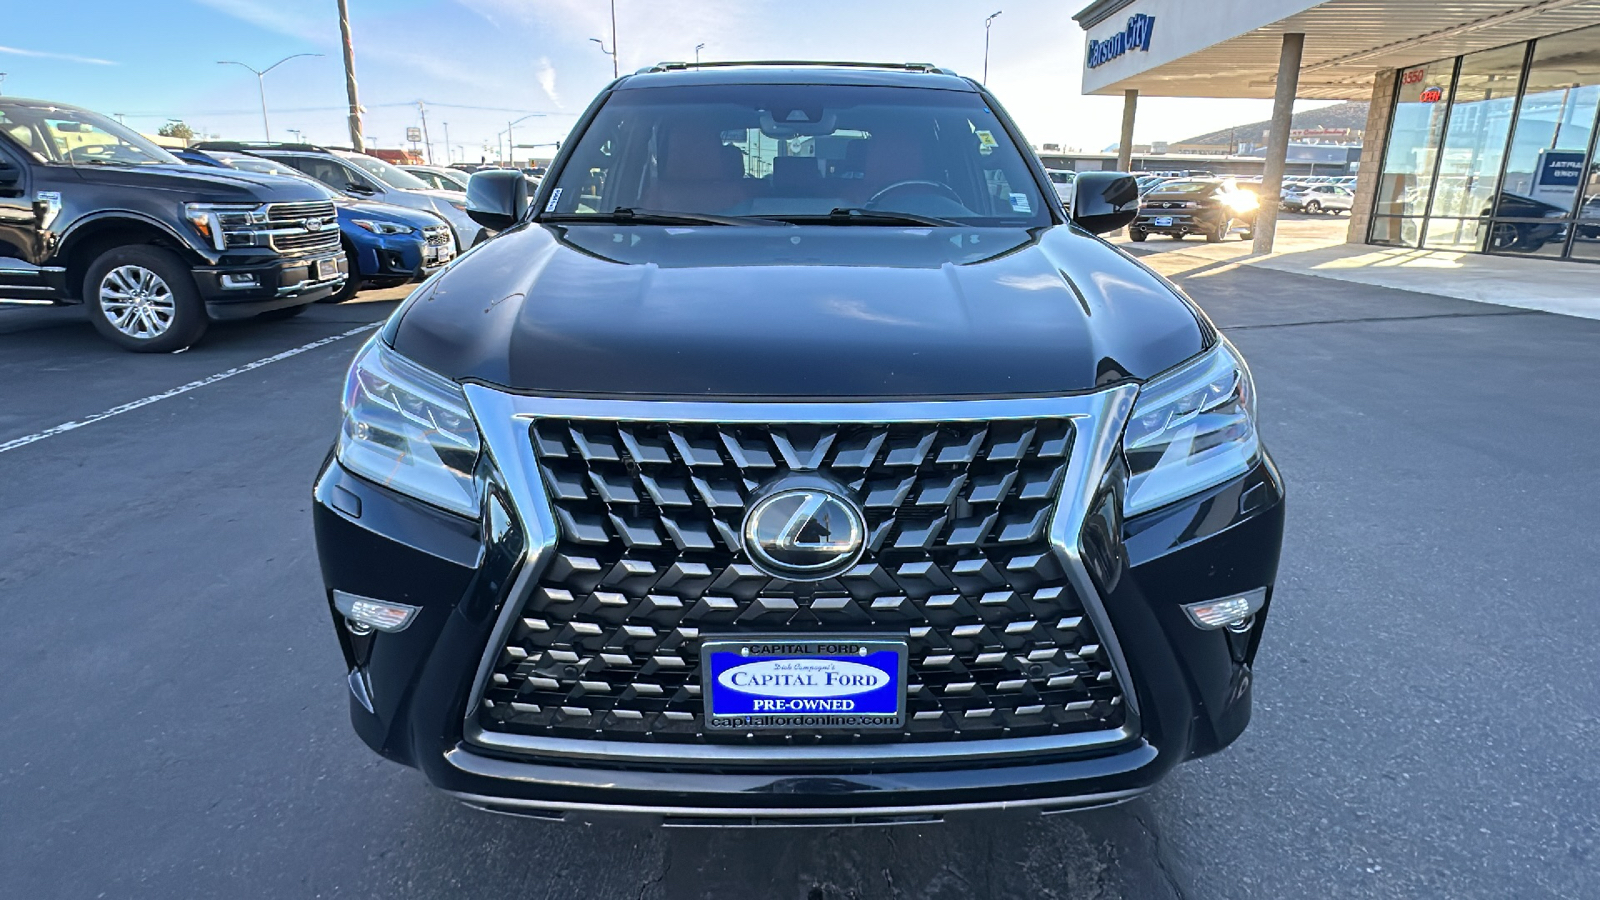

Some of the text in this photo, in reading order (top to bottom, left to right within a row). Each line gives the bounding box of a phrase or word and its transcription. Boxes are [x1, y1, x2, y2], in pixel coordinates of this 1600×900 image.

[1087, 13, 1155, 68] Carson City
[1419, 91, 1440, 103] OPEN
[750, 645, 859, 654] CAPITAL FORD
[731, 671, 878, 686] CAPITAL FORD
[753, 699, 855, 711] PRE-OWNED
